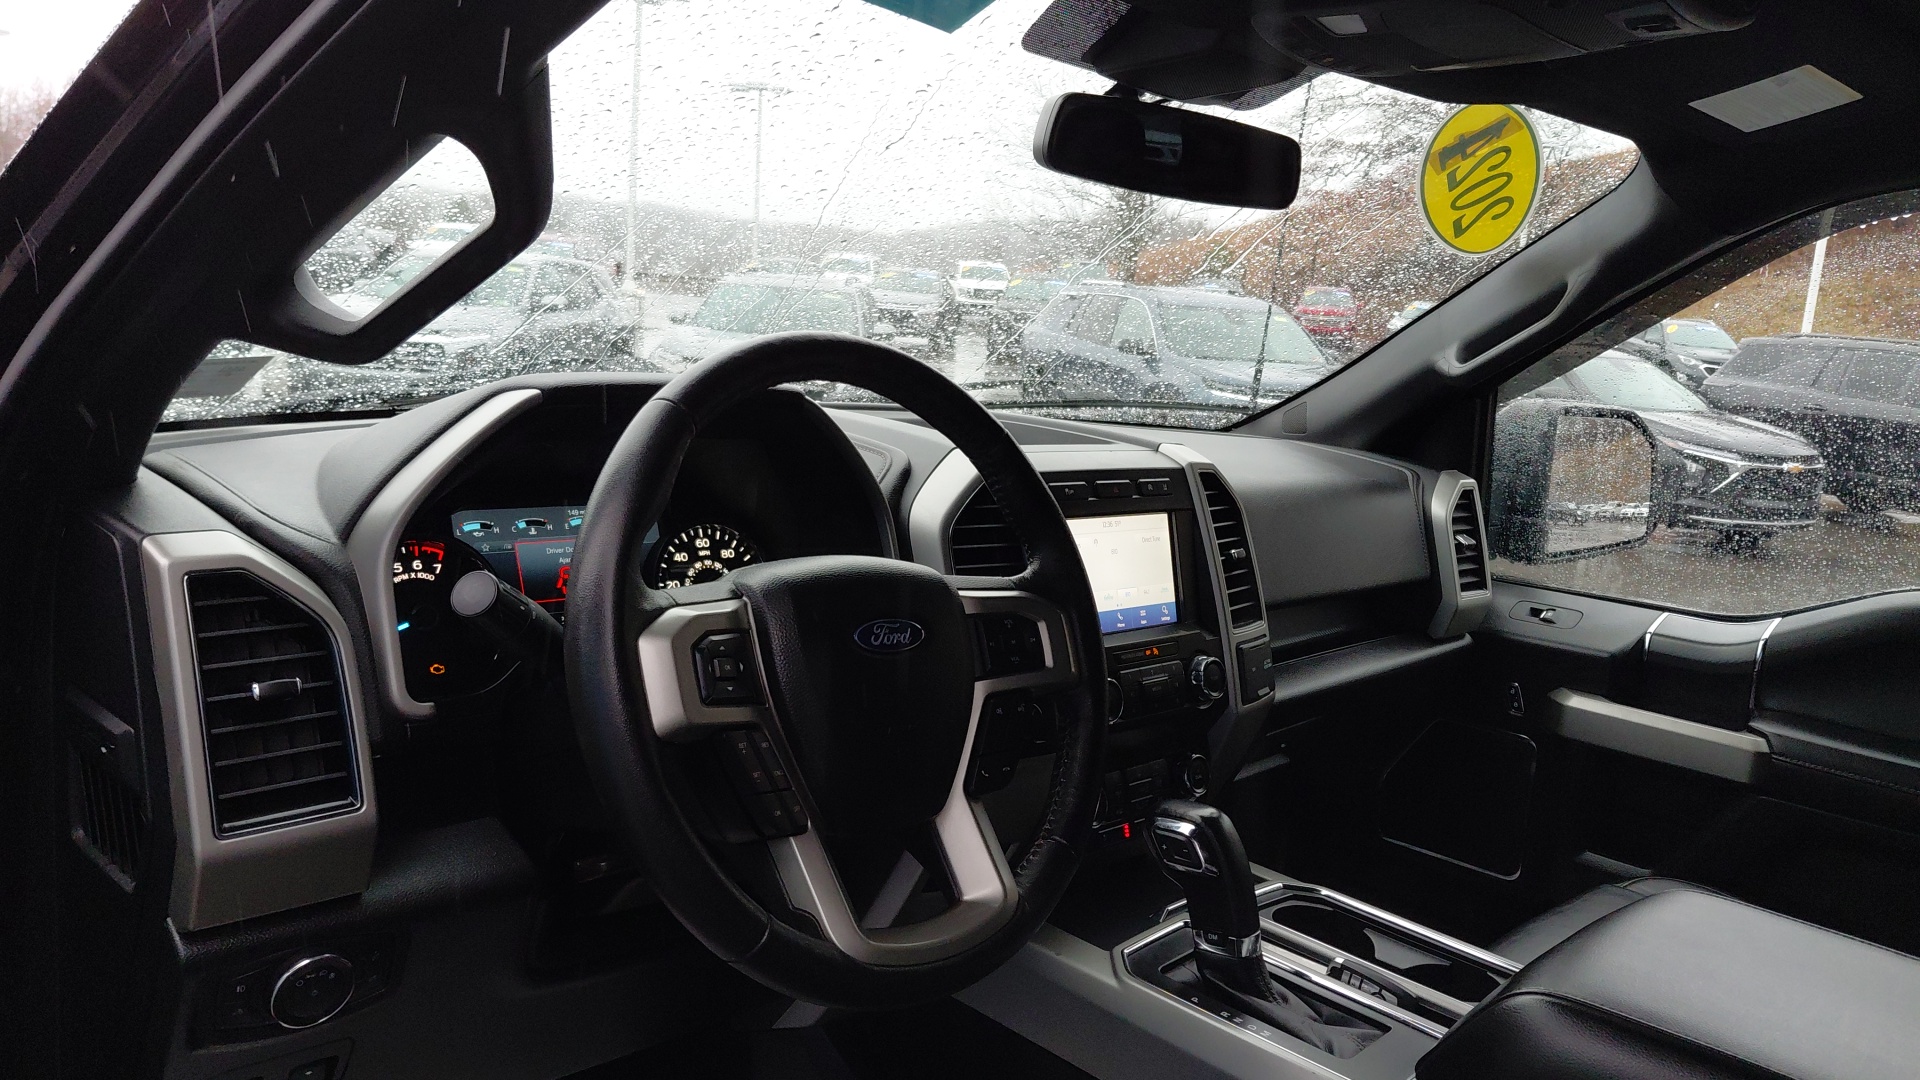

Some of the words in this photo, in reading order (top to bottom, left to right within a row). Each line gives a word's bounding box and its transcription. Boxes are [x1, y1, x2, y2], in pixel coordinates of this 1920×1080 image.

[694, 538, 710, 548] 60
[546, 547, 564, 555] Driver
[720, 549, 735, 559] 80
[673, 552, 689, 562] 40
[393, 562, 403, 573] 5
[412, 559, 423, 570] 6
[432, 563, 442, 574] 7
[393, 573, 409, 583] RPM
[417, 572, 435, 581] 1000
[665, 580, 681, 589] 20
[870, 622, 913, 646] Ford
[1190, 996, 1199, 1004] P
[1232, 1016, 1244, 1024] N
